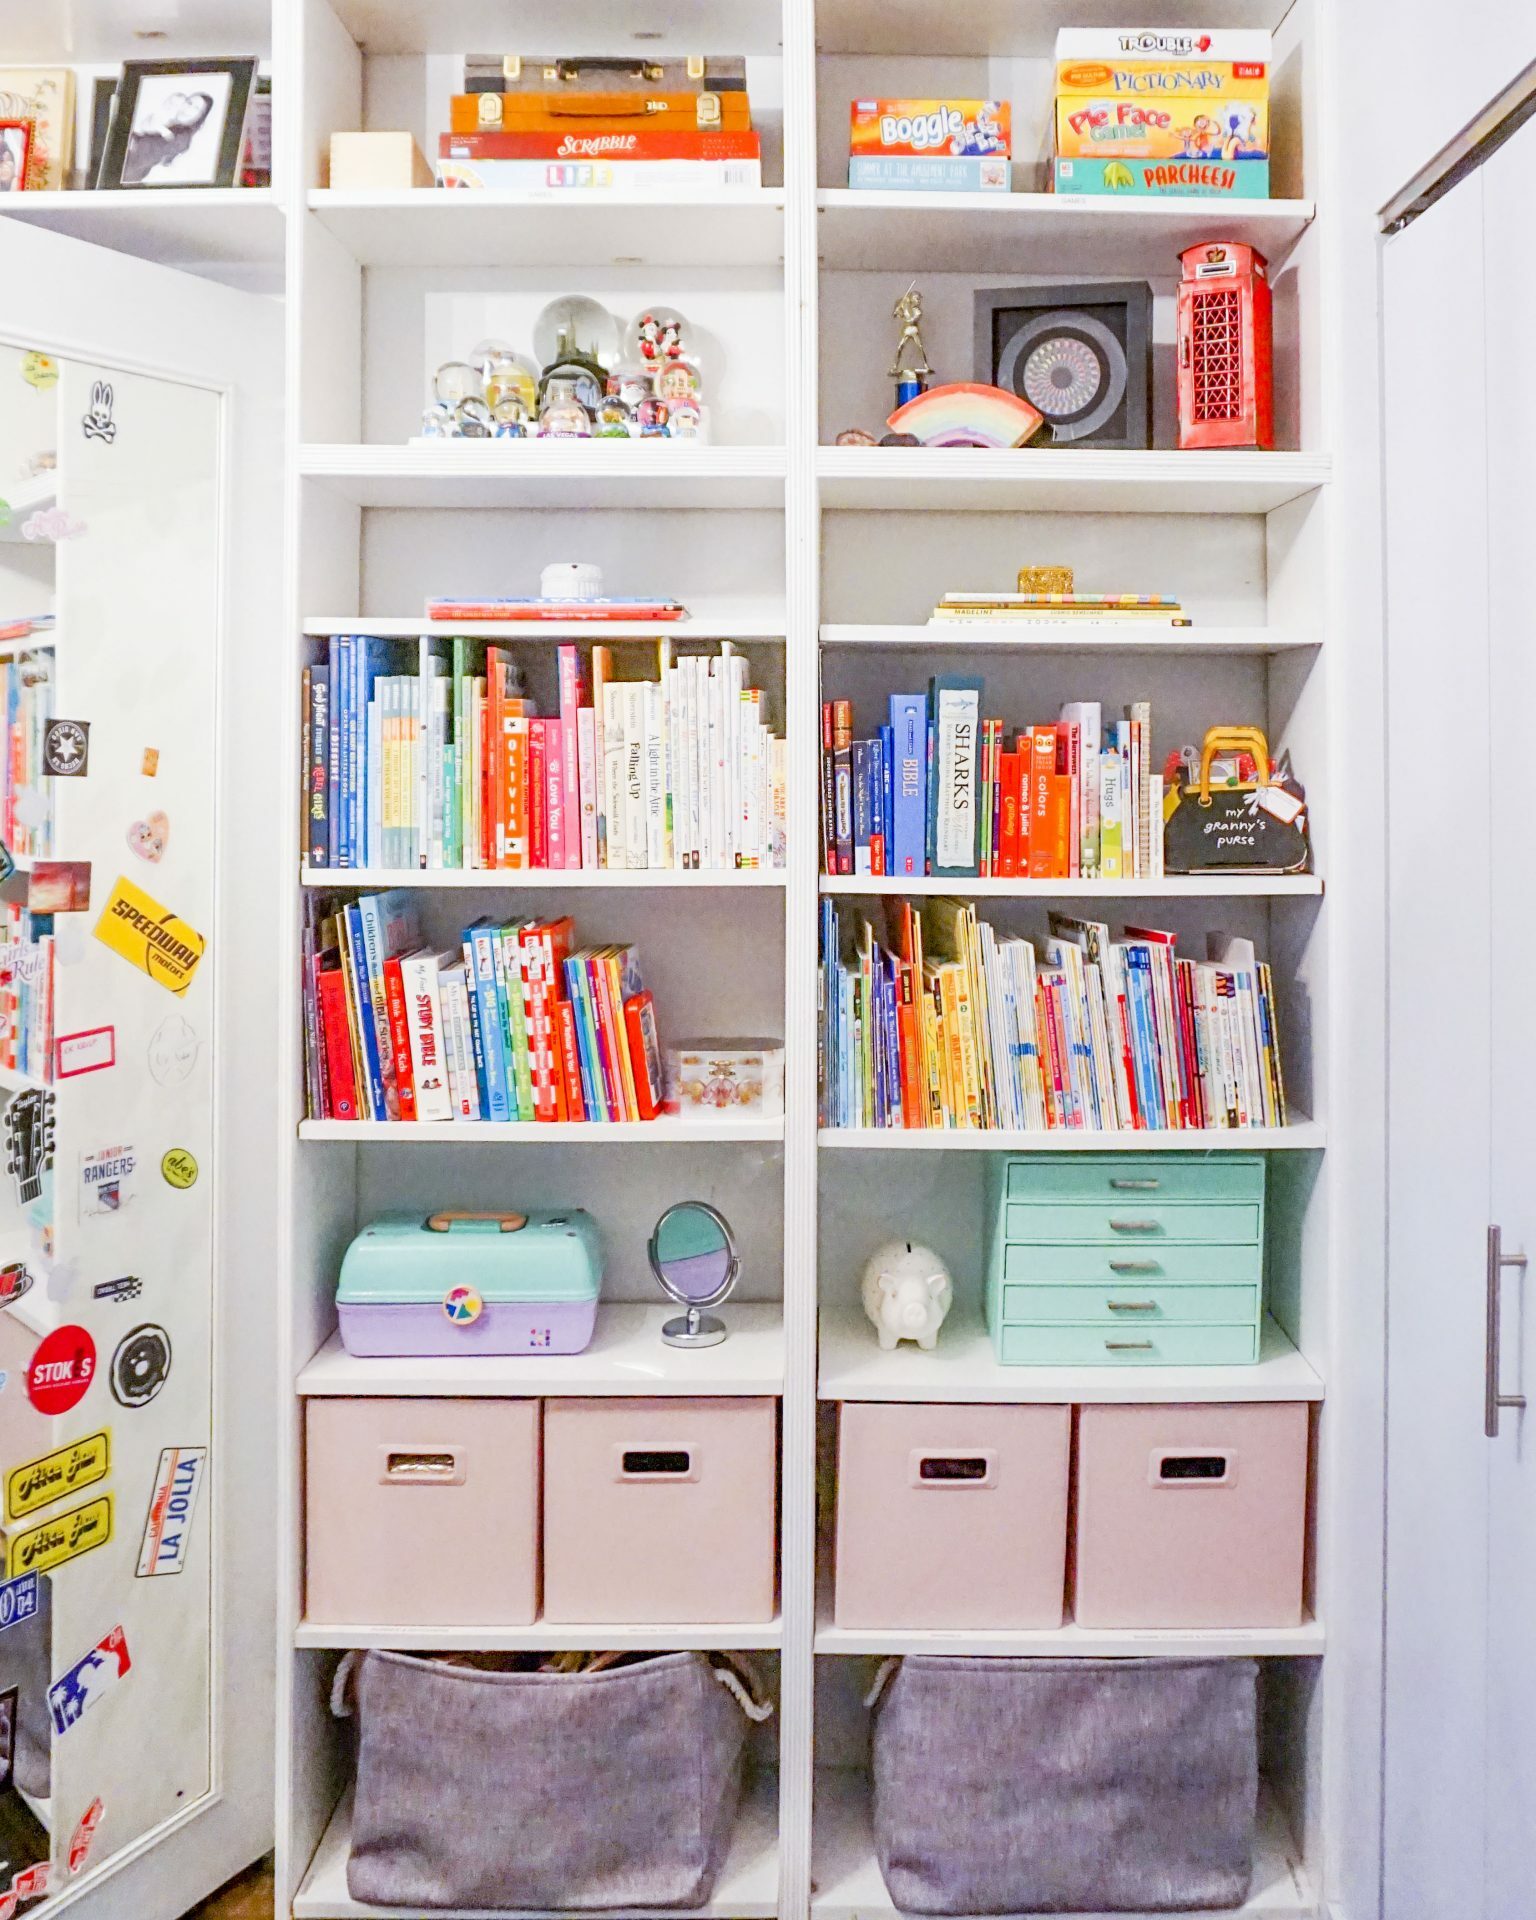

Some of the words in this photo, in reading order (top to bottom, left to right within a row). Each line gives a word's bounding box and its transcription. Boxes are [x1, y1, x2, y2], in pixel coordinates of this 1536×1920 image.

[1118, 32, 1192, 53] TROUBLE
[1114, 70, 1224, 92] PICTIONARY
[881, 106, 963, 147] Boggle
[1068, 106, 1109, 136] Pie
[1116, 103, 1172, 129] Face
[557, 135, 638, 156] SCRABBLE
[546, 165, 613, 187] LIFE
[1143, 163, 1236, 190] PARCHEESI
[954, 608, 994, 616] MADELINE
[331, 735, 339, 782] DISSENT
[628, 742, 640, 781] Falling
[647, 743, 662, 766] Light
[953, 724, 971, 810] SHARKS
[313, 765, 326, 792] REBEL
[508, 738, 517, 831] OLIVIA
[650, 767, 661, 777] in
[651, 778, 661, 793] the
[902, 759, 918, 797] BIBLE
[550, 777, 559, 805] Love
[628, 782, 641, 799] Up
[1037, 775, 1049, 817] colors
[1104, 778, 1117, 808] Hugs
[312, 793, 325, 820] GIRLS
[550, 808, 559, 830] You
[650, 794, 662, 817] Attic
[780, 811, 785, 821] MY
[1225, 807, 1245, 819] my
[1020, 813, 1029, 835] juliet
[1217, 835, 1256, 849] purse
[111, 897, 200, 971] SPEEDWAY
[365, 912, 376, 961] Children's
[354, 940, 364, 963] Minute
[151, 953, 185, 980] motors
[371, 962, 381, 995] illustrated
[374, 996, 386, 1026] BIBLE
[392, 999, 400, 1017] Bible
[416, 995, 433, 1030] STUDY
[484, 991, 495, 1007] BIG
[562, 1008, 571, 1025] HAPPY
[379, 1027, 390, 1060] Stories
[395, 1020, 404, 1045] Travels
[398, 1053, 408, 1072] Kids
[419, 1033, 436, 1066] BIBLE
[96, 1145, 124, 1162] JUNIOR
[84, 1156, 136, 1185] RANGERS
[167, 1156, 195, 1179] abe's
[33, 1357, 92, 1385] STOKS
[166, 1457, 198, 1525] JOLLA
[157, 1532, 183, 1561] LA
